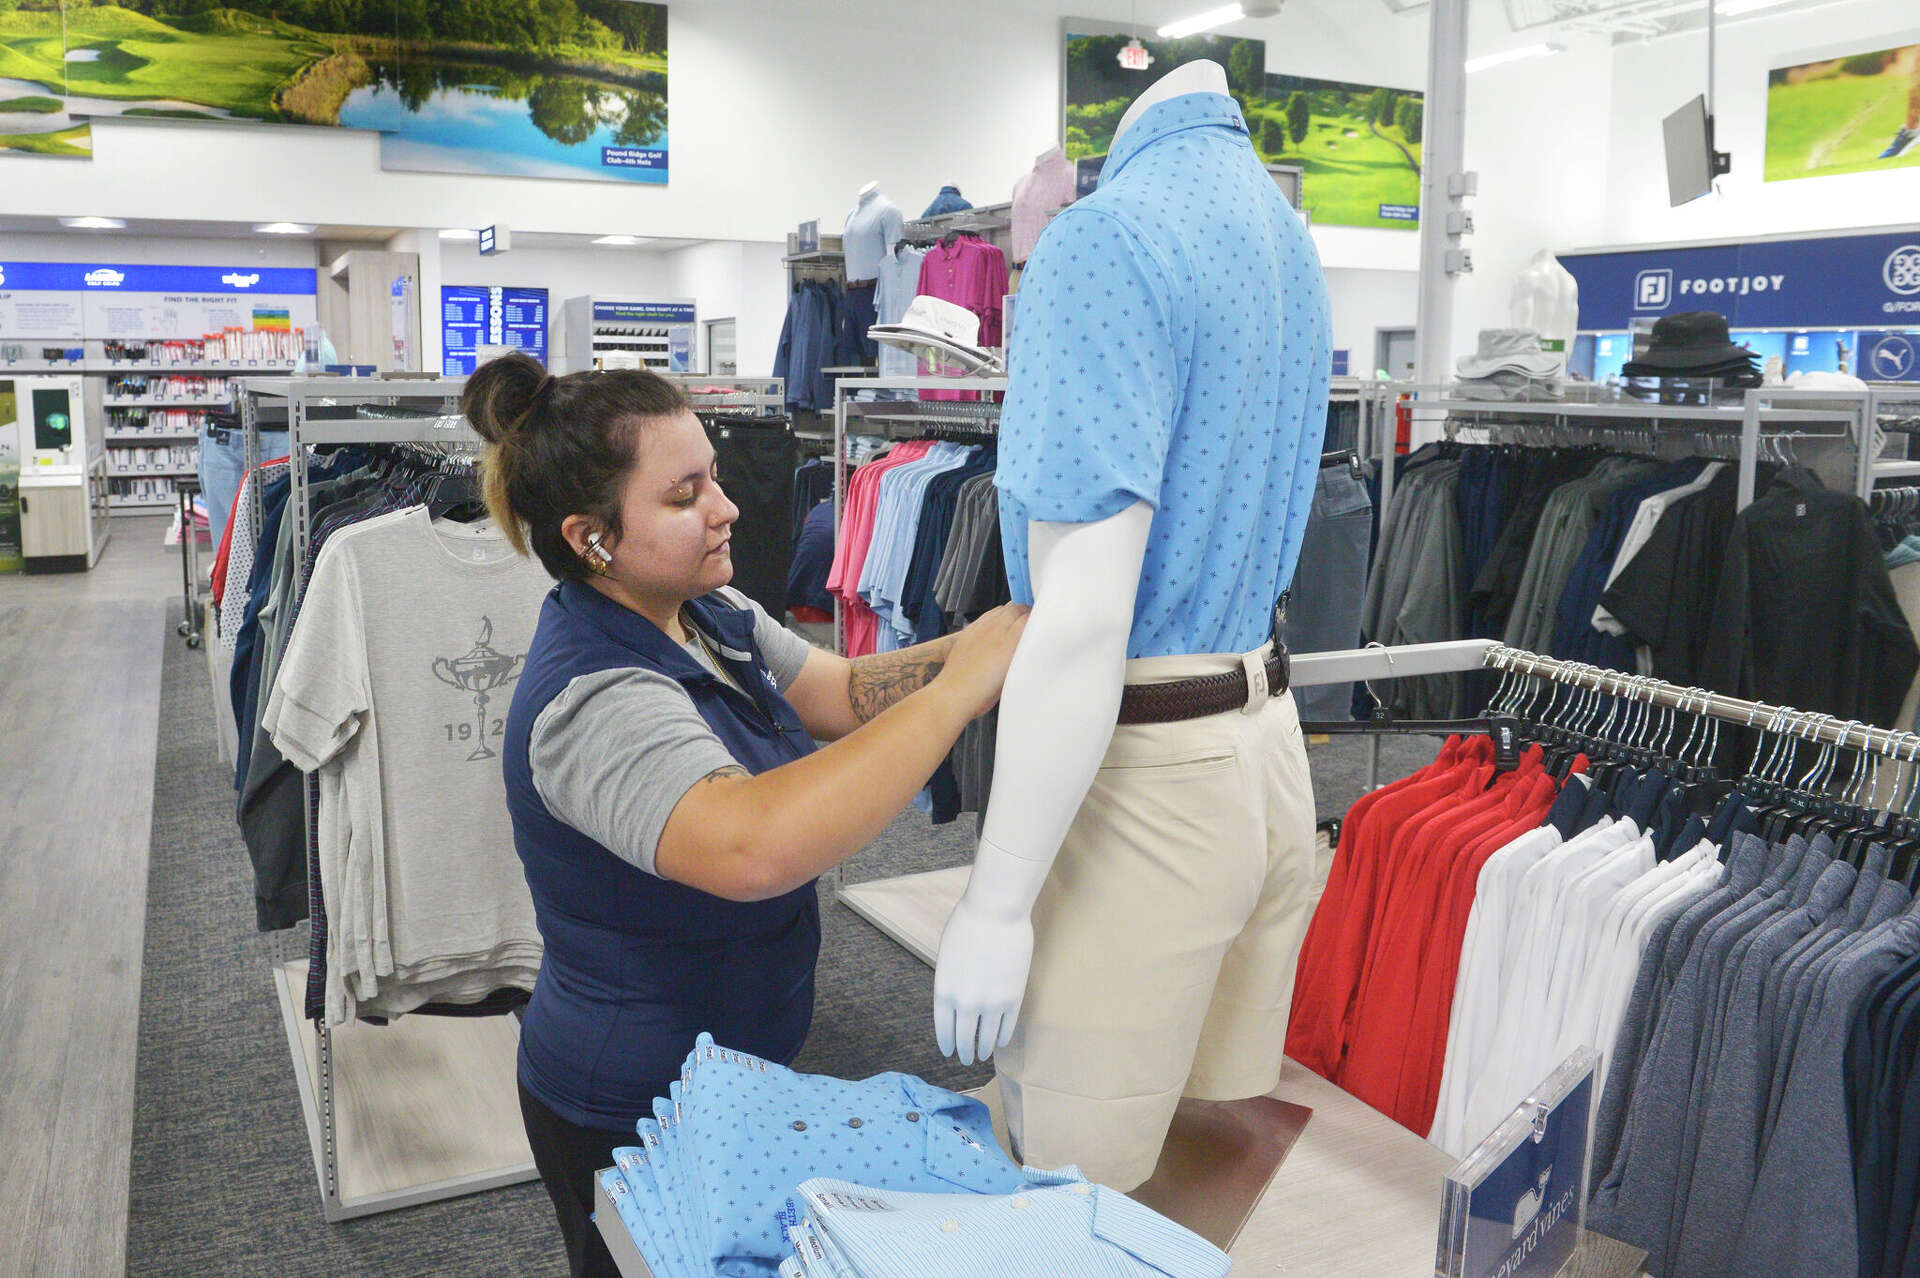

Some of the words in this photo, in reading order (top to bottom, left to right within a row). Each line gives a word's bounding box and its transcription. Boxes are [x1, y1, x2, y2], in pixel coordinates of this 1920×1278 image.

[606, 149, 628, 157] Pound
[628, 150, 648, 158] Ridge
[648, 151, 663, 159] Golf
[1679, 274, 1785, 295] FOOTJOY
[489, 286, 503, 346] ESSONS
[444, 722, 472, 741] 19
[491, 718, 505, 736] 2
[785, 1200, 798, 1227] BETH
[816, 1193, 833, 1209] Small
[777, 1210, 791, 1243] BLACK
[1492, 1217, 1539, 1278] eyard
[1540, 1184, 1575, 1237] vines
[808, 1235, 823, 1261] Medium
